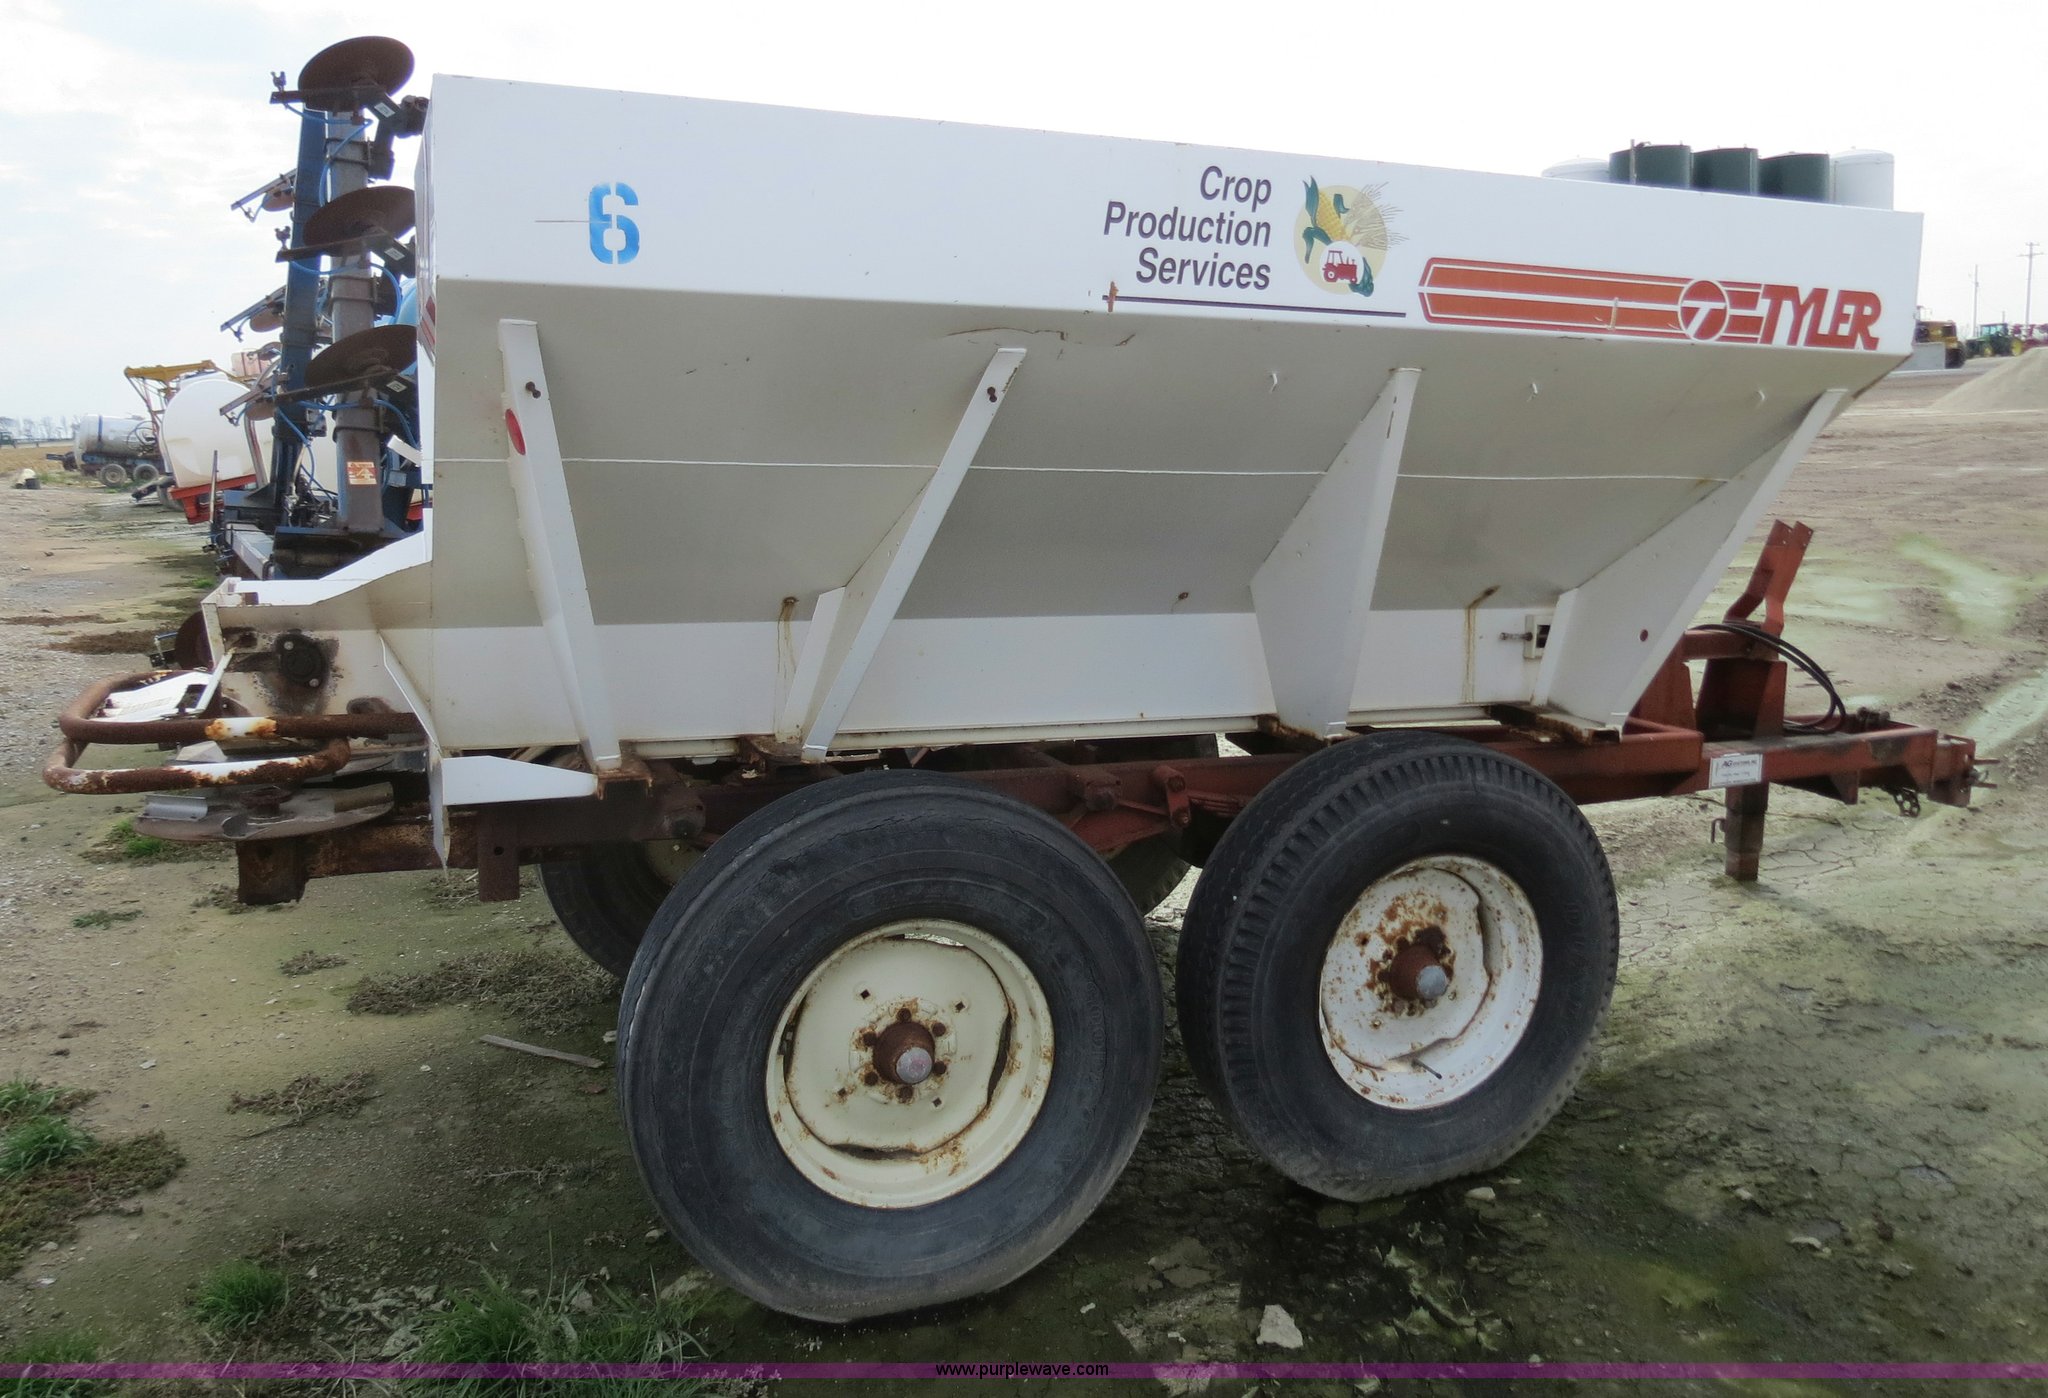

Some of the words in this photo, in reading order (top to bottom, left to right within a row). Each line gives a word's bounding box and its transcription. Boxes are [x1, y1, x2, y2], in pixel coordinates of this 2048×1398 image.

[1200, 165, 1272, 213] Crop
[588, 181, 640, 265] 6
[1103, 200, 1271, 248] Production
[1135, 246, 1271, 291] Services
[1758, 283, 1882, 351] TYLER
